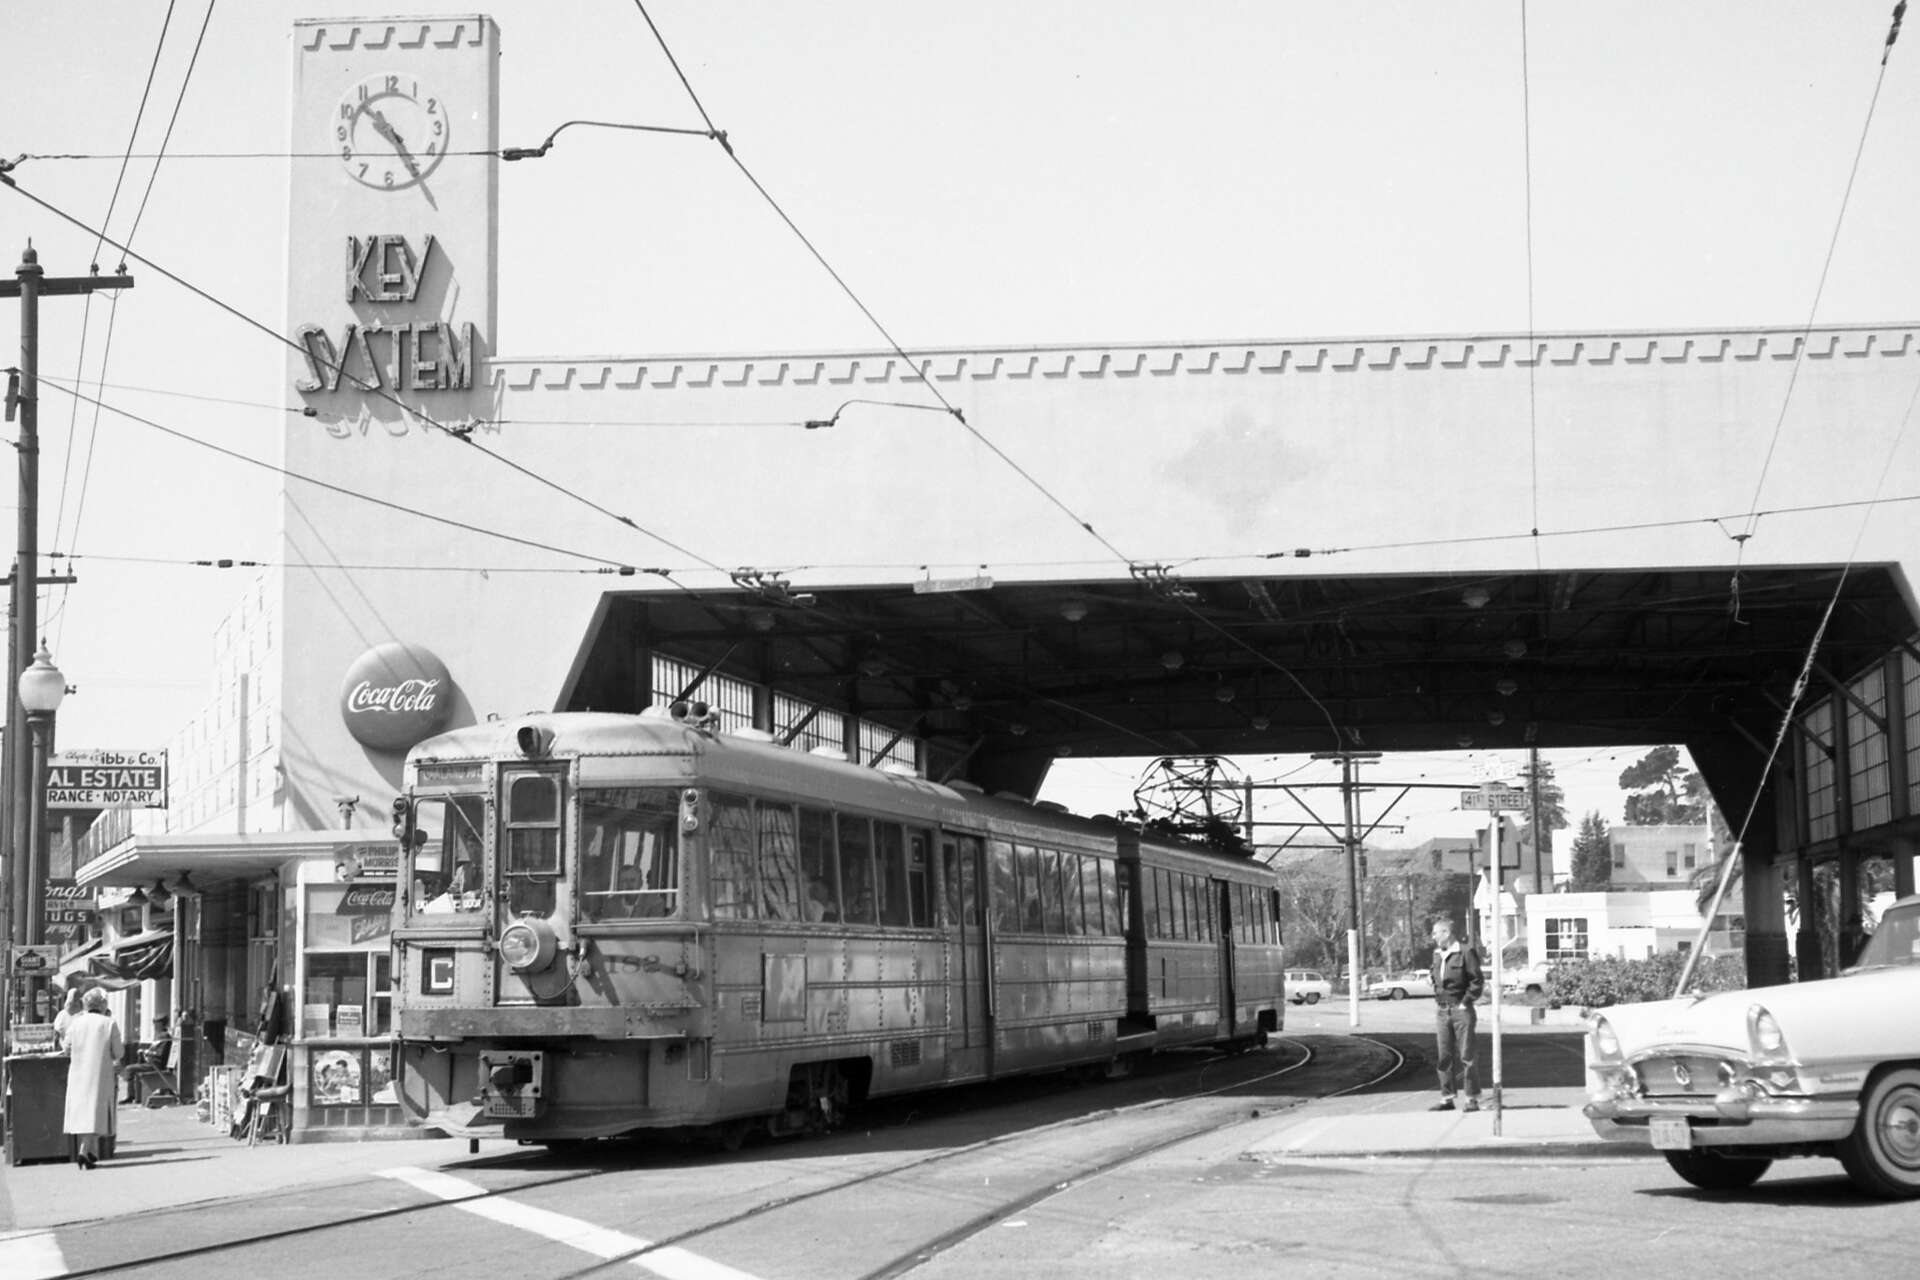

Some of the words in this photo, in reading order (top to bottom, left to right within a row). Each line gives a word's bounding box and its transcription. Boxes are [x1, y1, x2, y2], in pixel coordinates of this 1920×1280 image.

[385, 75, 399, 93] 12
[412, 81, 418, 98] 1
[358, 85, 368, 101] 11
[341, 104, 354, 120] 10
[427, 98, 437, 114] 2
[337, 126, 347, 142] 9
[433, 121, 442, 136] 3
[342, 146, 352, 161] 8
[425, 142, 436, 156] 4
[358, 163, 369, 178] 7
[384, 171, 394, 186] 6
[346, 234, 434, 302] KEY
[296, 321, 473, 391] SYSTEM
[348, 679, 440, 713] Coca-Cola
[47, 769, 75, 787] AL
[81, 769, 155, 787] ESTATE
[48, 790, 93, 802] RANCE
[103, 790, 153, 802] NOTARY
[1488, 794, 1525, 807] STREET
[45, 911, 86, 922] UGS
[608, 955, 661, 974] 182
[431, 957, 453, 989] C
